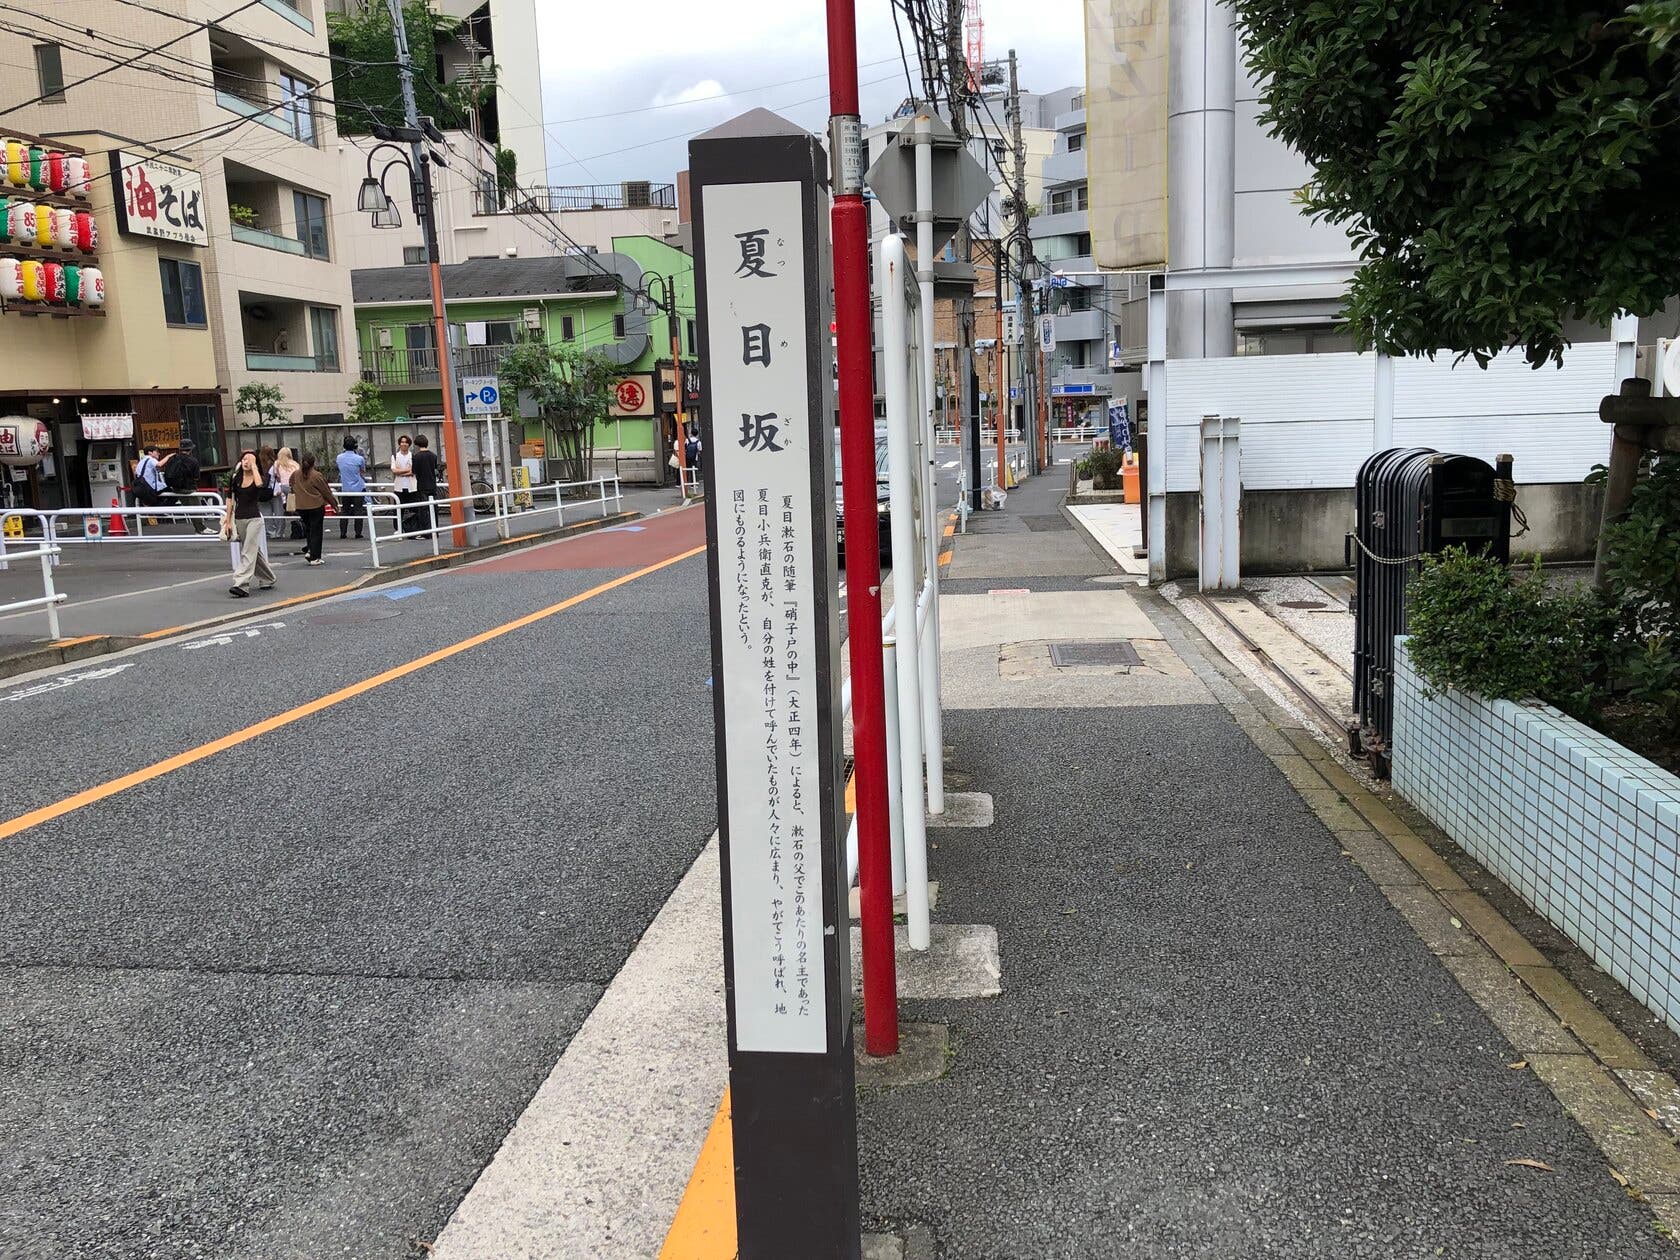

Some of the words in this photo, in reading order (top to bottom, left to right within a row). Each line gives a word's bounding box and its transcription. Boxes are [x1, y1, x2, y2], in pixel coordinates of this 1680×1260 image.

[125, 164, 204, 232] 油そば
[776, 237, 786, 267] なつ
[734, 228, 785, 453] 夏目坂
[780, 340, 788, 348] め
[783, 416, 793, 447] ざか
[733, 489, 753, 650] 図にものるようになったという。
